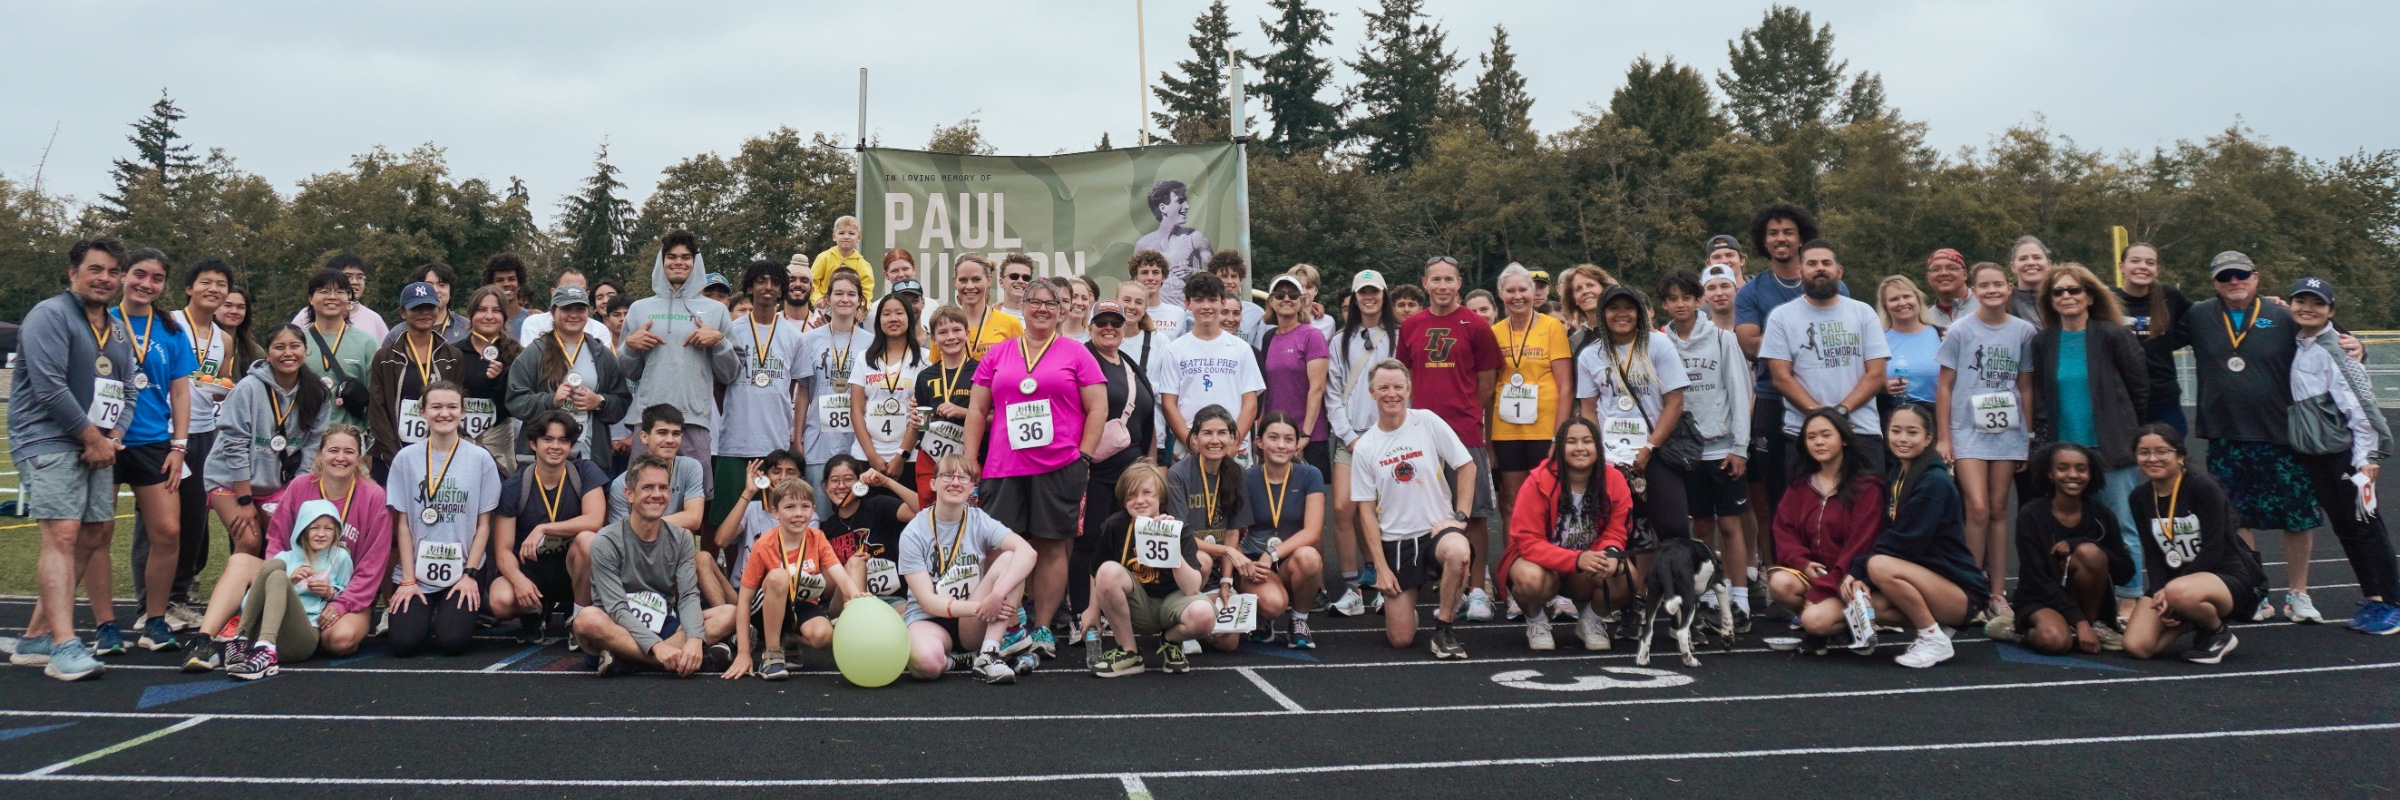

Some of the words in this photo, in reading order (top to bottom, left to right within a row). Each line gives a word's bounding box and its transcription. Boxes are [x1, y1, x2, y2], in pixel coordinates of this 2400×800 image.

[885, 174, 896, 182] IN
[902, 174, 936, 182] LOVING
[942, 174, 975, 182] MEMORY
[980, 174, 992, 182] OF
[884, 192, 1022, 249] PAUL
[884, 251, 1086, 304] UTON
[1819, 321, 1848, 335] PAUL
[1424, 327, 1457, 363] TJ
[1821, 333, 1861, 348] RUSTON
[752, 347, 775, 358] PL
[833, 349, 855, 360] AUL
[1823, 346, 1862, 359] MEMORIAL
[1987, 346, 2012, 359] PAUL
[1180, 358, 1215, 370] SEATTLE
[1217, 358, 1238, 369] PREP
[1825, 358, 1840, 369] RUN
[1841, 357, 1851, 367] 5K
[1986, 359, 2020, 372] RUSTON
[1204, 367, 1236, 376] COUNTRY
[1986, 371, 2018, 381] MEMORIA
[927, 377, 972, 399] Tmas
[101, 401, 119, 422] 79
[1513, 402, 1520, 418] 1
[461, 416, 492, 434] 194
[829, 411, 850, 428] 85
[1986, 411, 2009, 429] 33
[881, 419, 892, 436] 4
[1019, 421, 1044, 442] 36
[1379, 456, 1400, 467] TEAM
[433, 490, 469, 503] RUSTON
[431, 503, 466, 514] MEMORIAL
[446, 513, 456, 523] 5K
[942, 544, 967, 560] PL
[1145, 539, 1169, 561] 35
[945, 553, 979, 567] STON
[426, 562, 452, 582] 86
[867, 574, 892, 595] 62
[949, 582, 971, 601] 34
